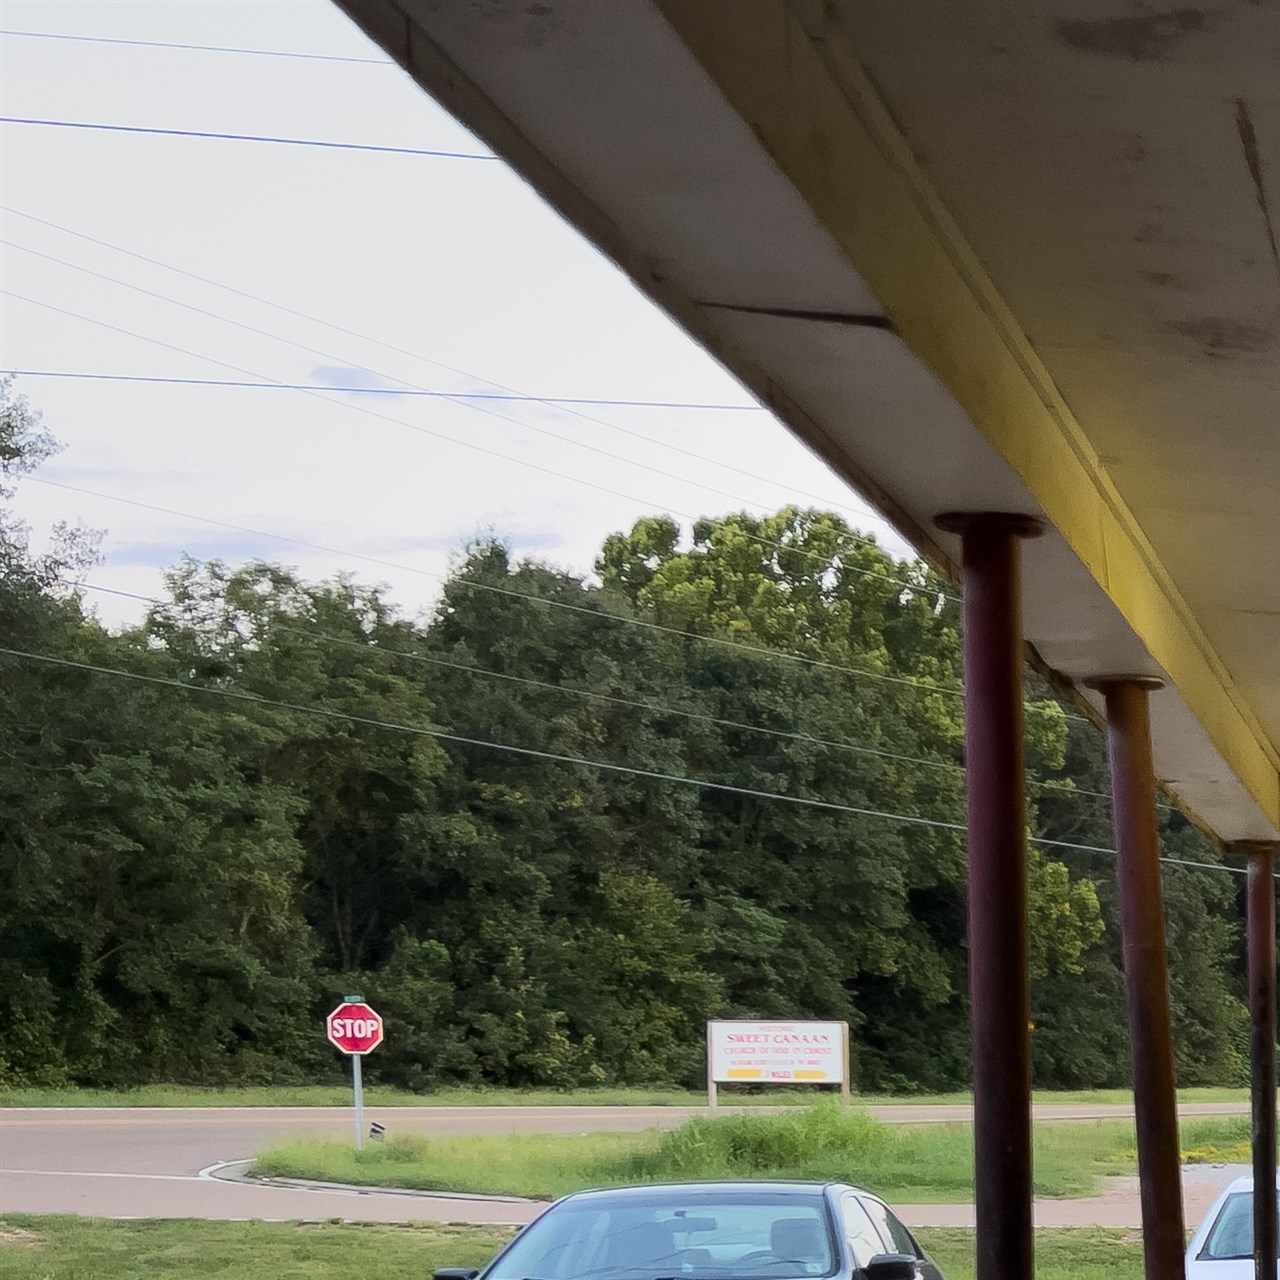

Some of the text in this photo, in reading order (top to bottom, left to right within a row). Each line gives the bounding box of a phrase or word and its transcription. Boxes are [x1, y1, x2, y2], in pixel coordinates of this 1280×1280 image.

[332, 1018, 379, 1038] STOP
[726, 1034, 829, 1044] SWEET CANAAN
